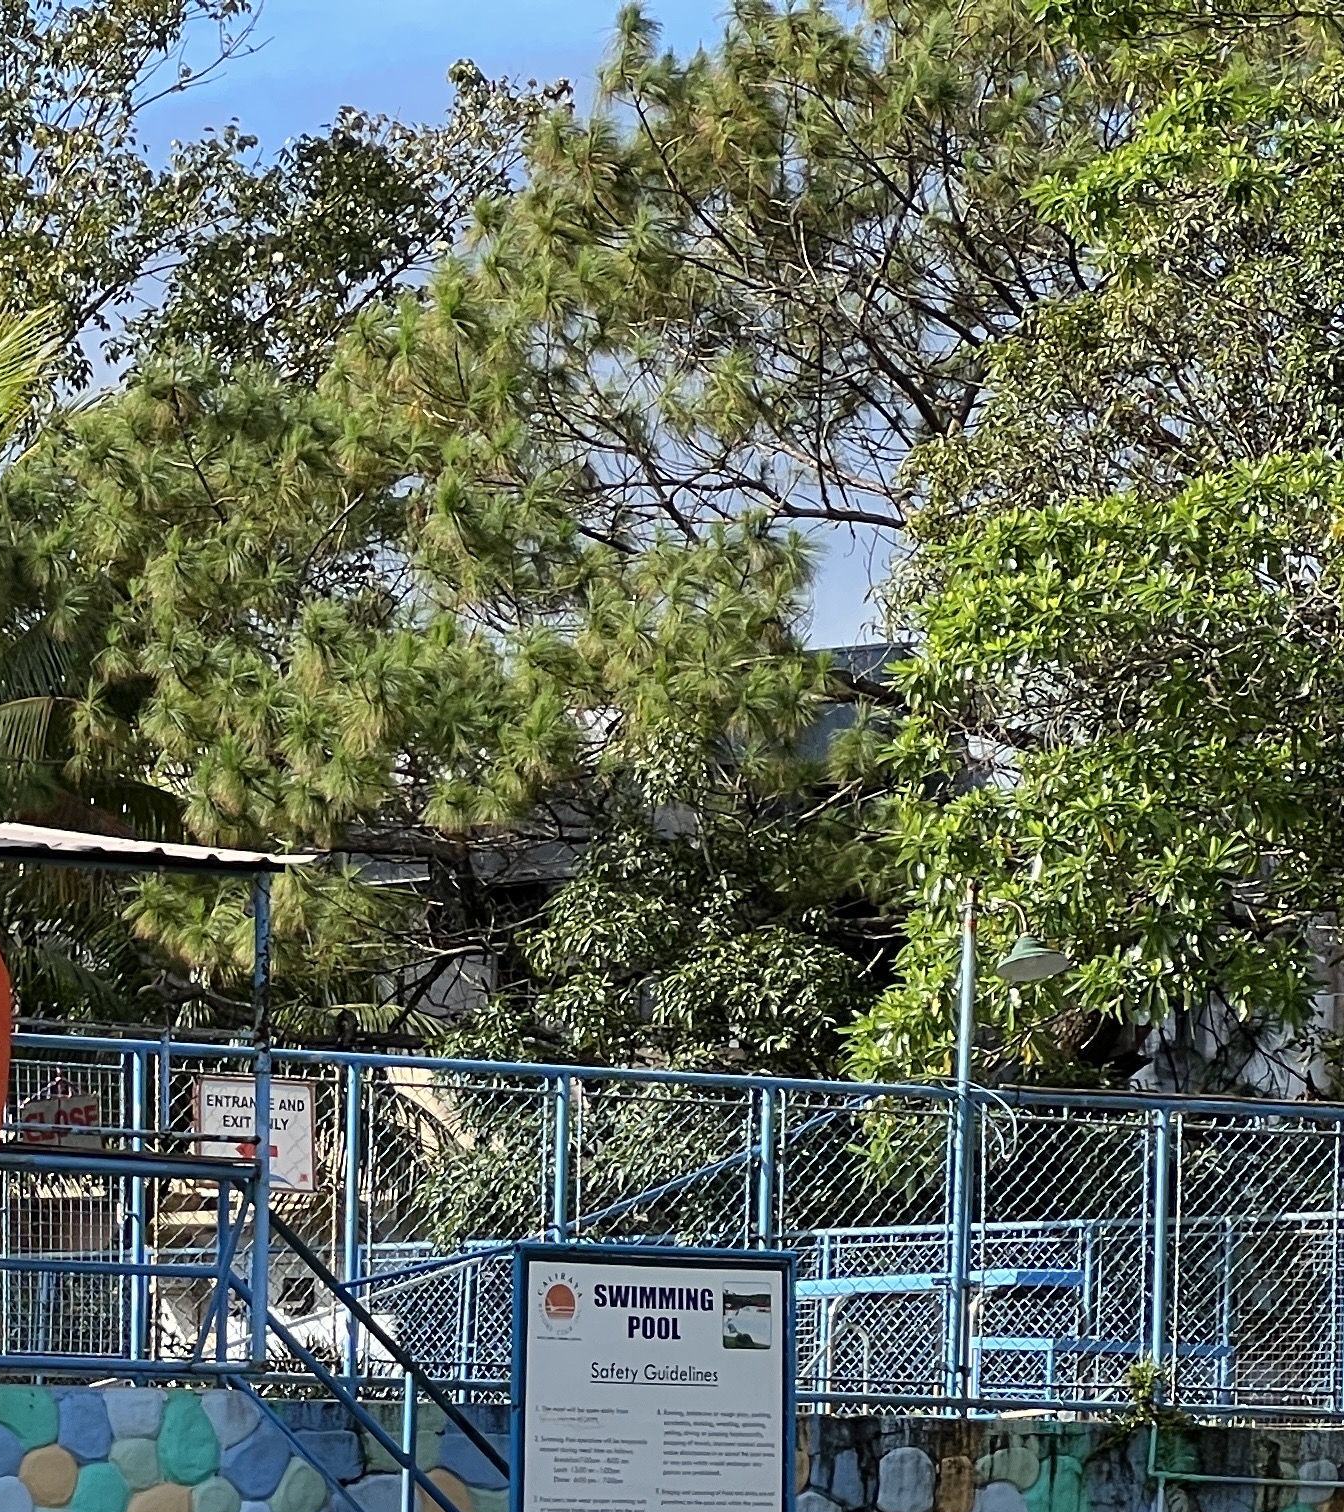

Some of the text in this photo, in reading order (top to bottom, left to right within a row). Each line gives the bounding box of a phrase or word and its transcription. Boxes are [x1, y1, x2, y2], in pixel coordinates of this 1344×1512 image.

[206, 1094, 305, 1112] ENTRANE AND
[223, 1115, 252, 1128] EXIT
[594, 1284, 714, 1311] SWIMMING
[628, 1316, 681, 1340] POOL
[591, 1362, 718, 1384] Safety Guidelines
